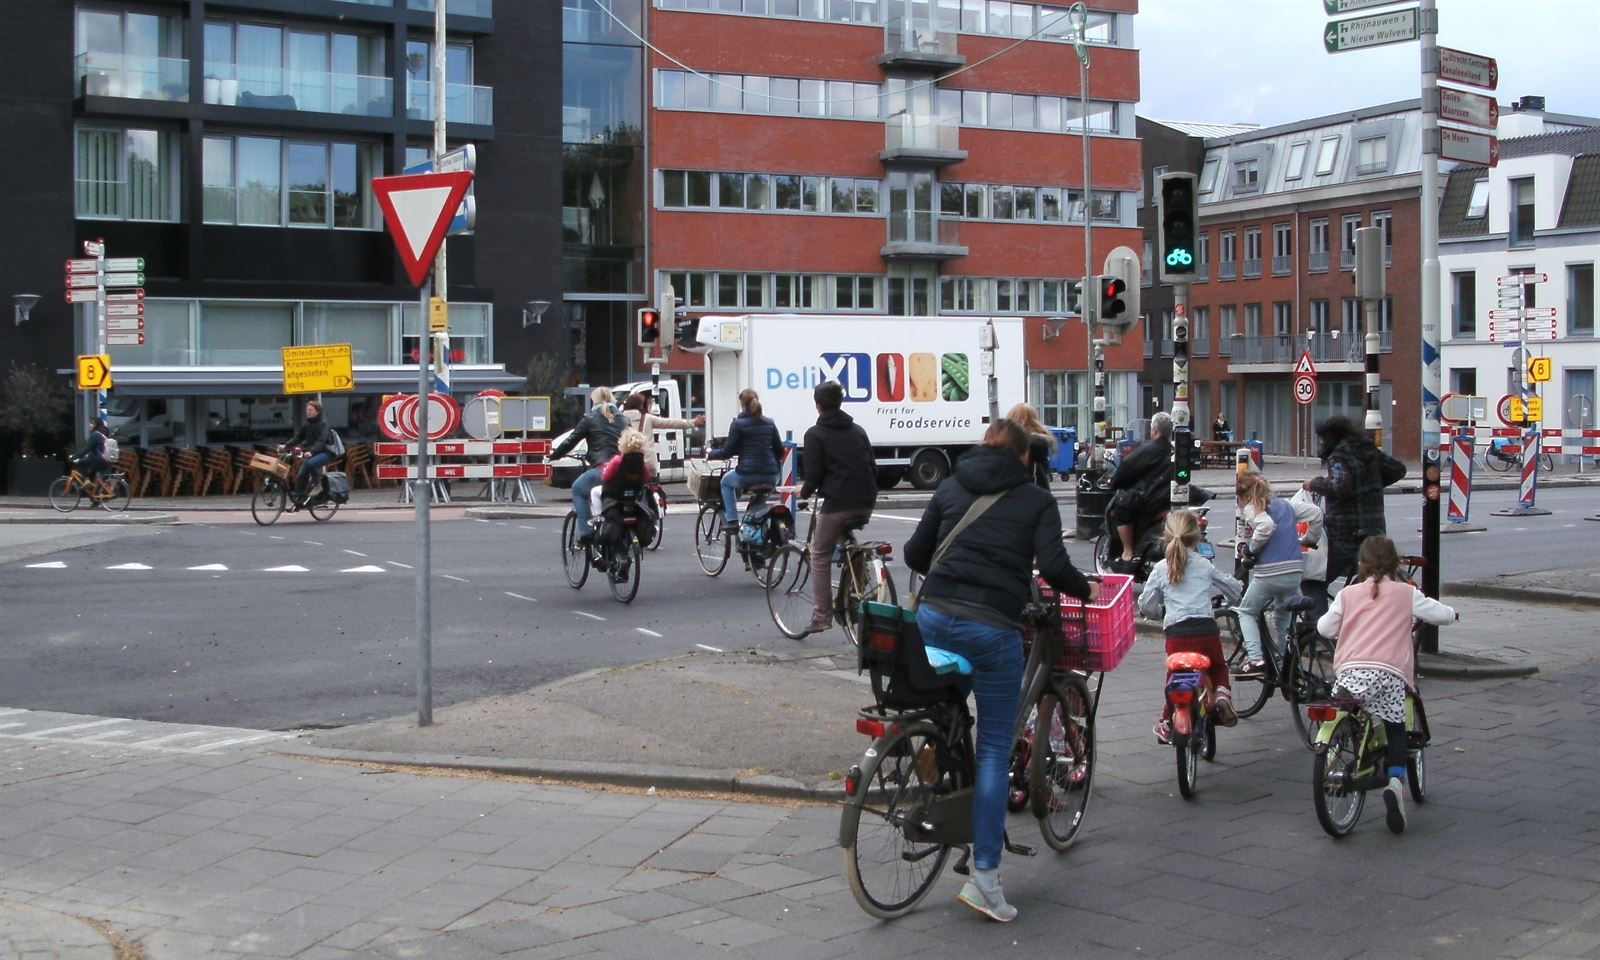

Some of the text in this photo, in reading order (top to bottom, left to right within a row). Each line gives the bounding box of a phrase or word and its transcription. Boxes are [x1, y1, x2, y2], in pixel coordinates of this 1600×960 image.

[1350, 16, 1398, 31] Rhijnauwen
[1350, 34, 1374, 43] Nieuw
[1377, 29, 1406, 39] Wulven
[285, 348, 326, 358] Omleiding
[87, 364, 95, 380] 8
[1537, 362, 1544, 375] 8
[1298, 383, 1312, 395] 30
[876, 406, 915, 415] First for
[889, 417, 971, 429] Foodservice
